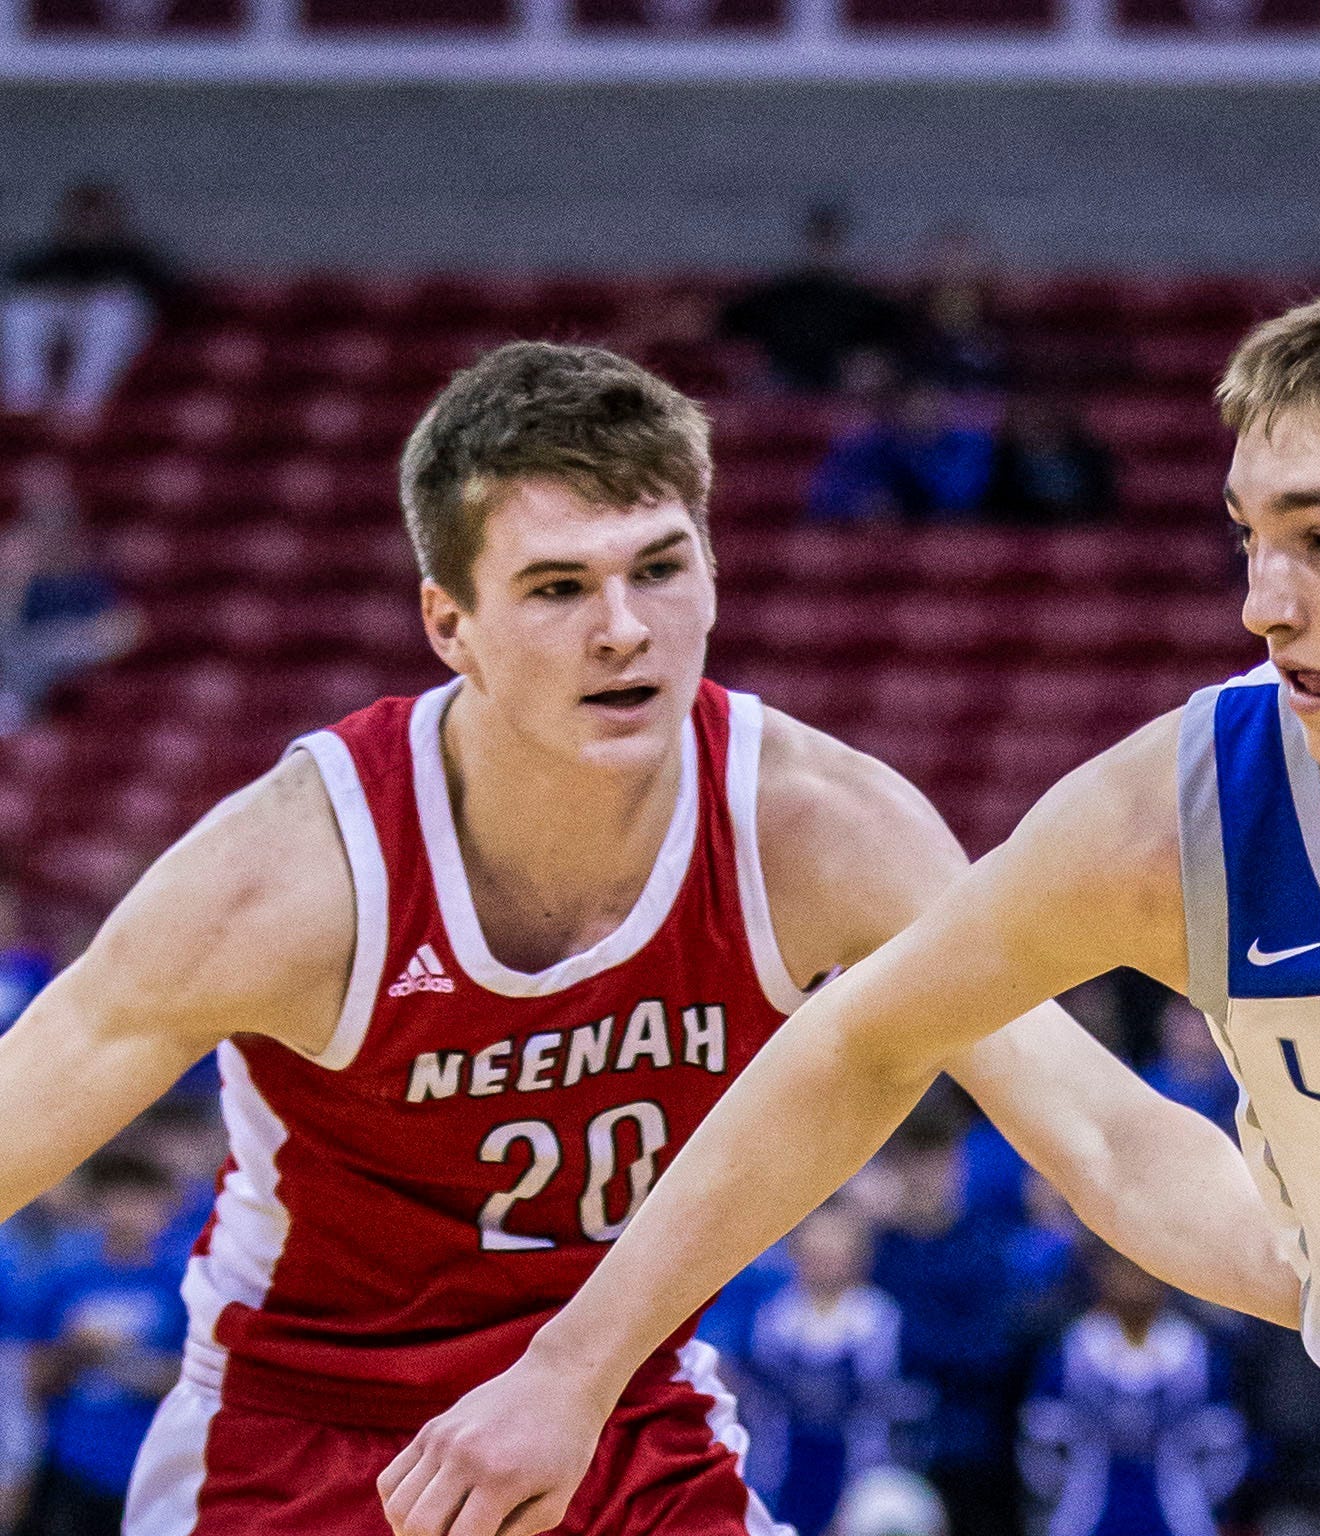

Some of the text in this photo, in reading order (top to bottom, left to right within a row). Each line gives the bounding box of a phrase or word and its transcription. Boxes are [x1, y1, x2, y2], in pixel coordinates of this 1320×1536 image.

[388, 974, 455, 997] adidas
[405, 1000, 727, 1103] NEENAH
[476, 1100, 669, 1251] 20
